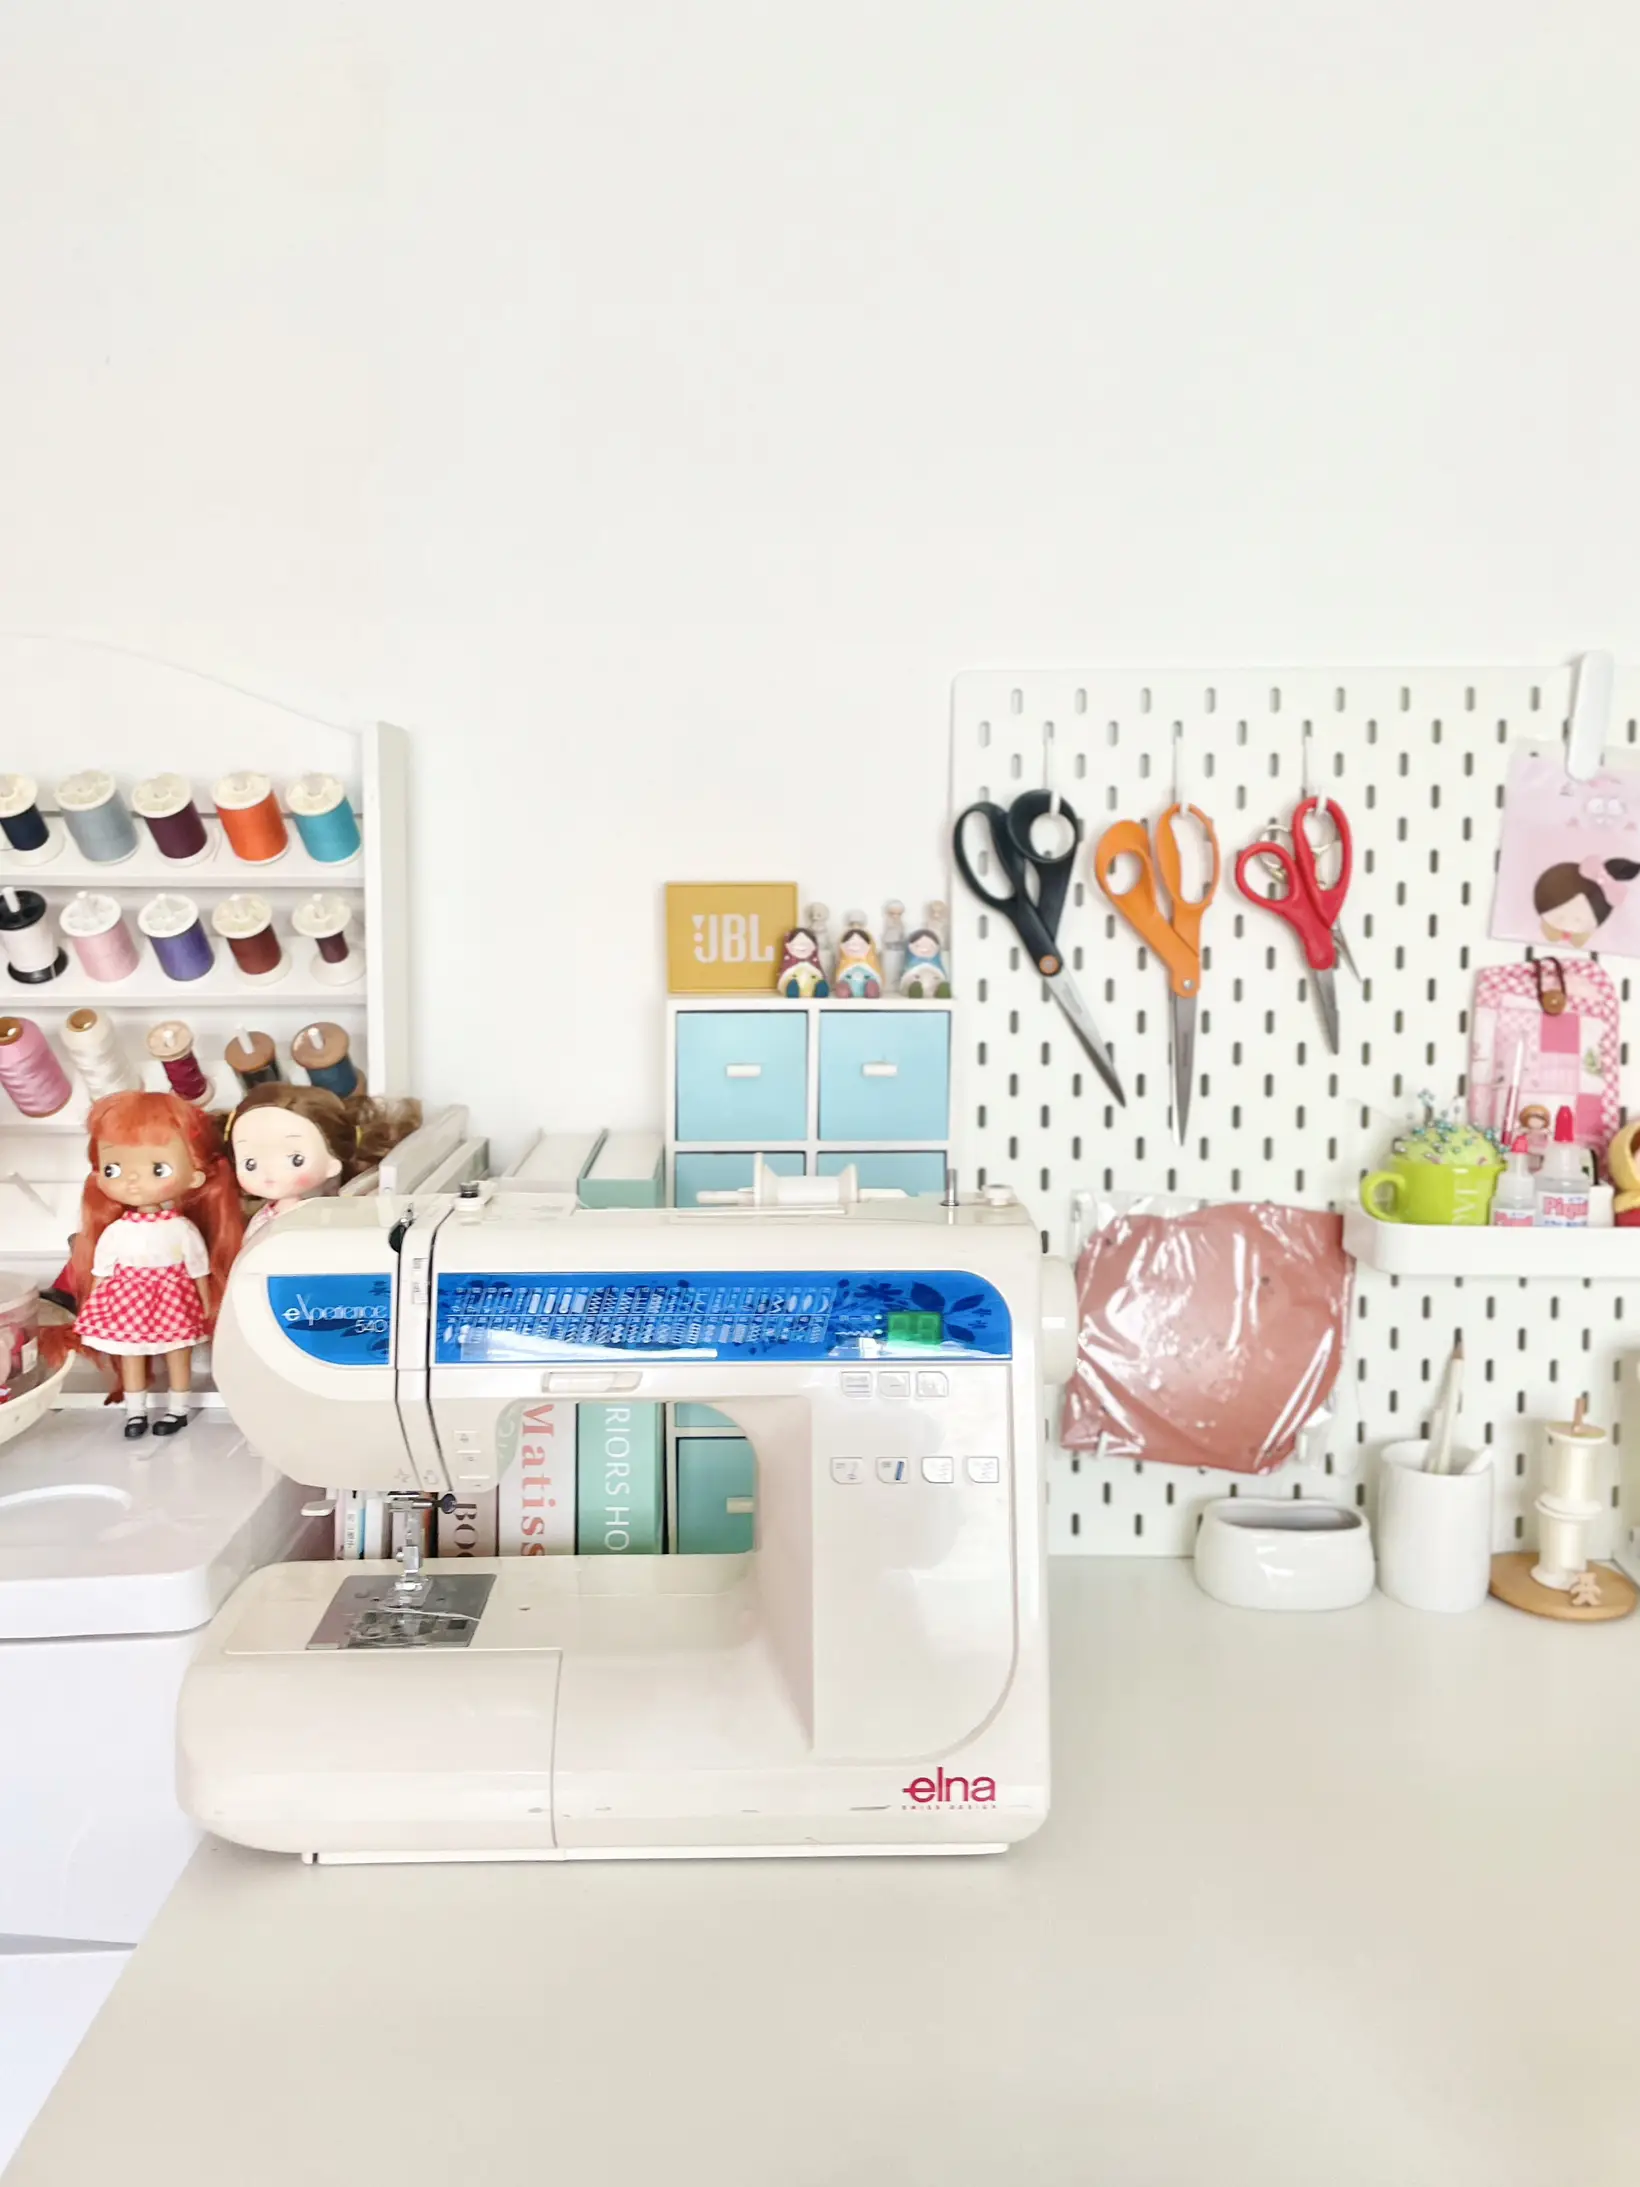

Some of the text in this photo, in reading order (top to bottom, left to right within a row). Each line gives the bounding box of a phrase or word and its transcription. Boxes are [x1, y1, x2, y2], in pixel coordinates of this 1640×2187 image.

[692, 913, 775, 963] JBL
[355, 1319, 389, 1334] 540
[521, 1403, 556, 1556] Matiss
[604, 1408, 631, 1551] RIORS HO
[902, 1766, 996, 1803] elna
